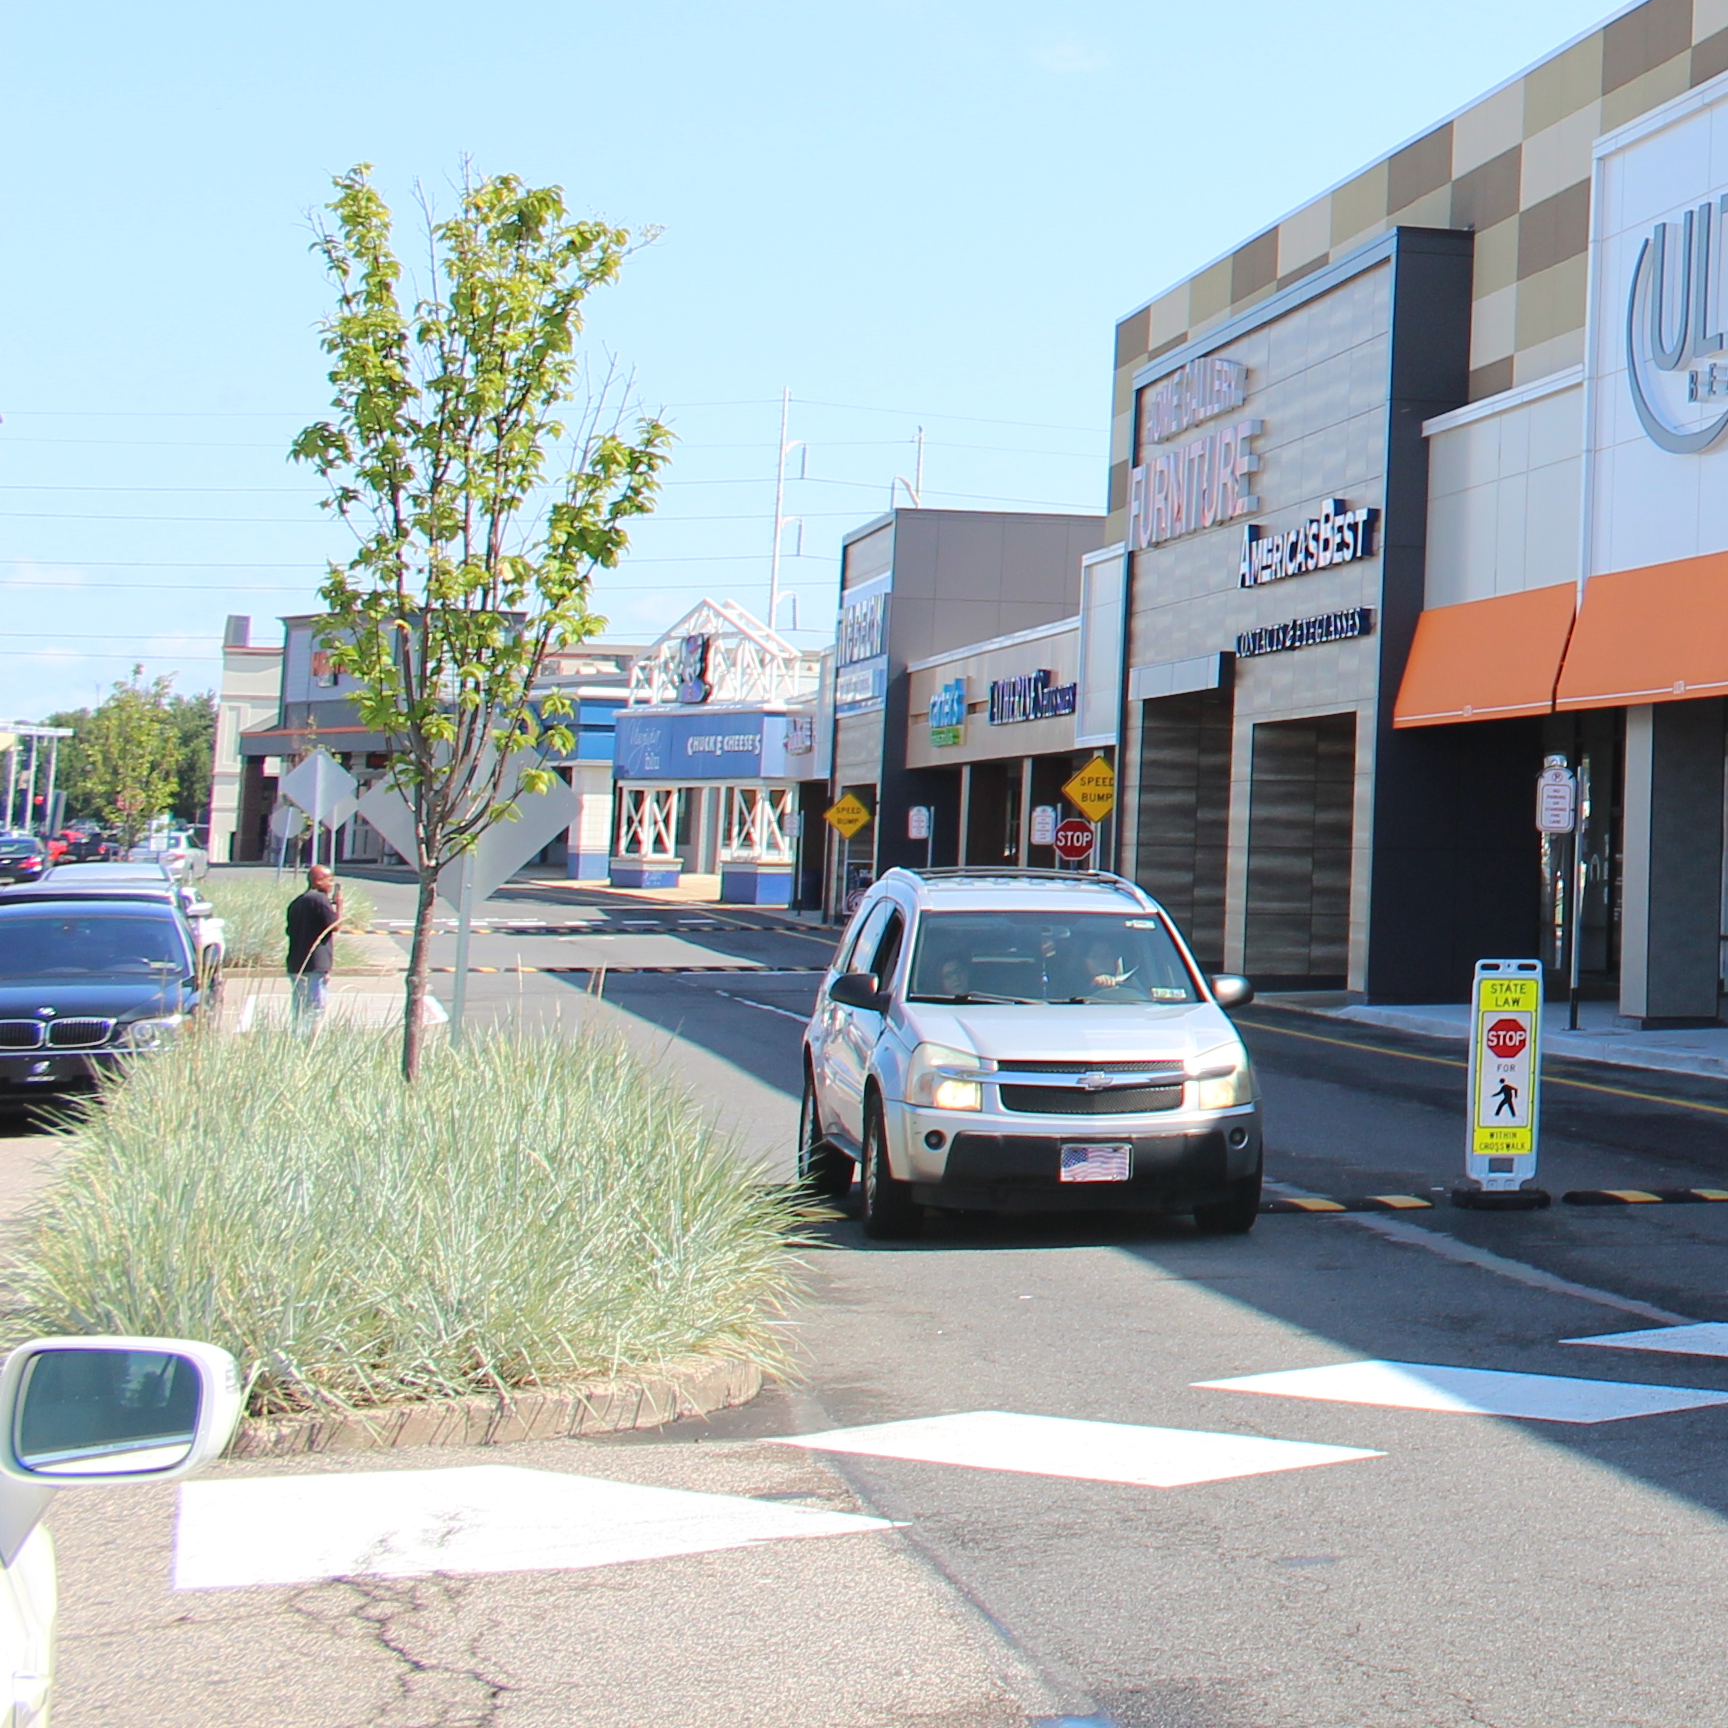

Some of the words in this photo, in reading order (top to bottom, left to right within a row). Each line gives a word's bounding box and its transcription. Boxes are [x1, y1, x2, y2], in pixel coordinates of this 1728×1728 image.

[1182, 356, 1242, 427] GALLERY
[1129, 421, 1258, 551] FURNITURE
[1295, 607, 1361, 647] EYEGLASSES
[687, 735, 715, 756] CHUCK
[723, 733, 761, 755] CHEESE'S
[1080, 776, 1114, 788] SPEED
[1081, 792, 1113, 803] BUMP
[836, 807, 862, 815] SPEED
[836, 817, 860, 825] BUMP
[1056, 831, 1092, 847] STOP
[1490, 983, 1527, 995] STATE
[1494, 997, 1522, 1007] LAW
[1487, 1030, 1527, 1048] STOP
[1496, 1063, 1517, 1072] FOR
[1489, 1131, 1518, 1140] WITHIN
[1478, 1142, 1527, 1151] CROSSWALK
